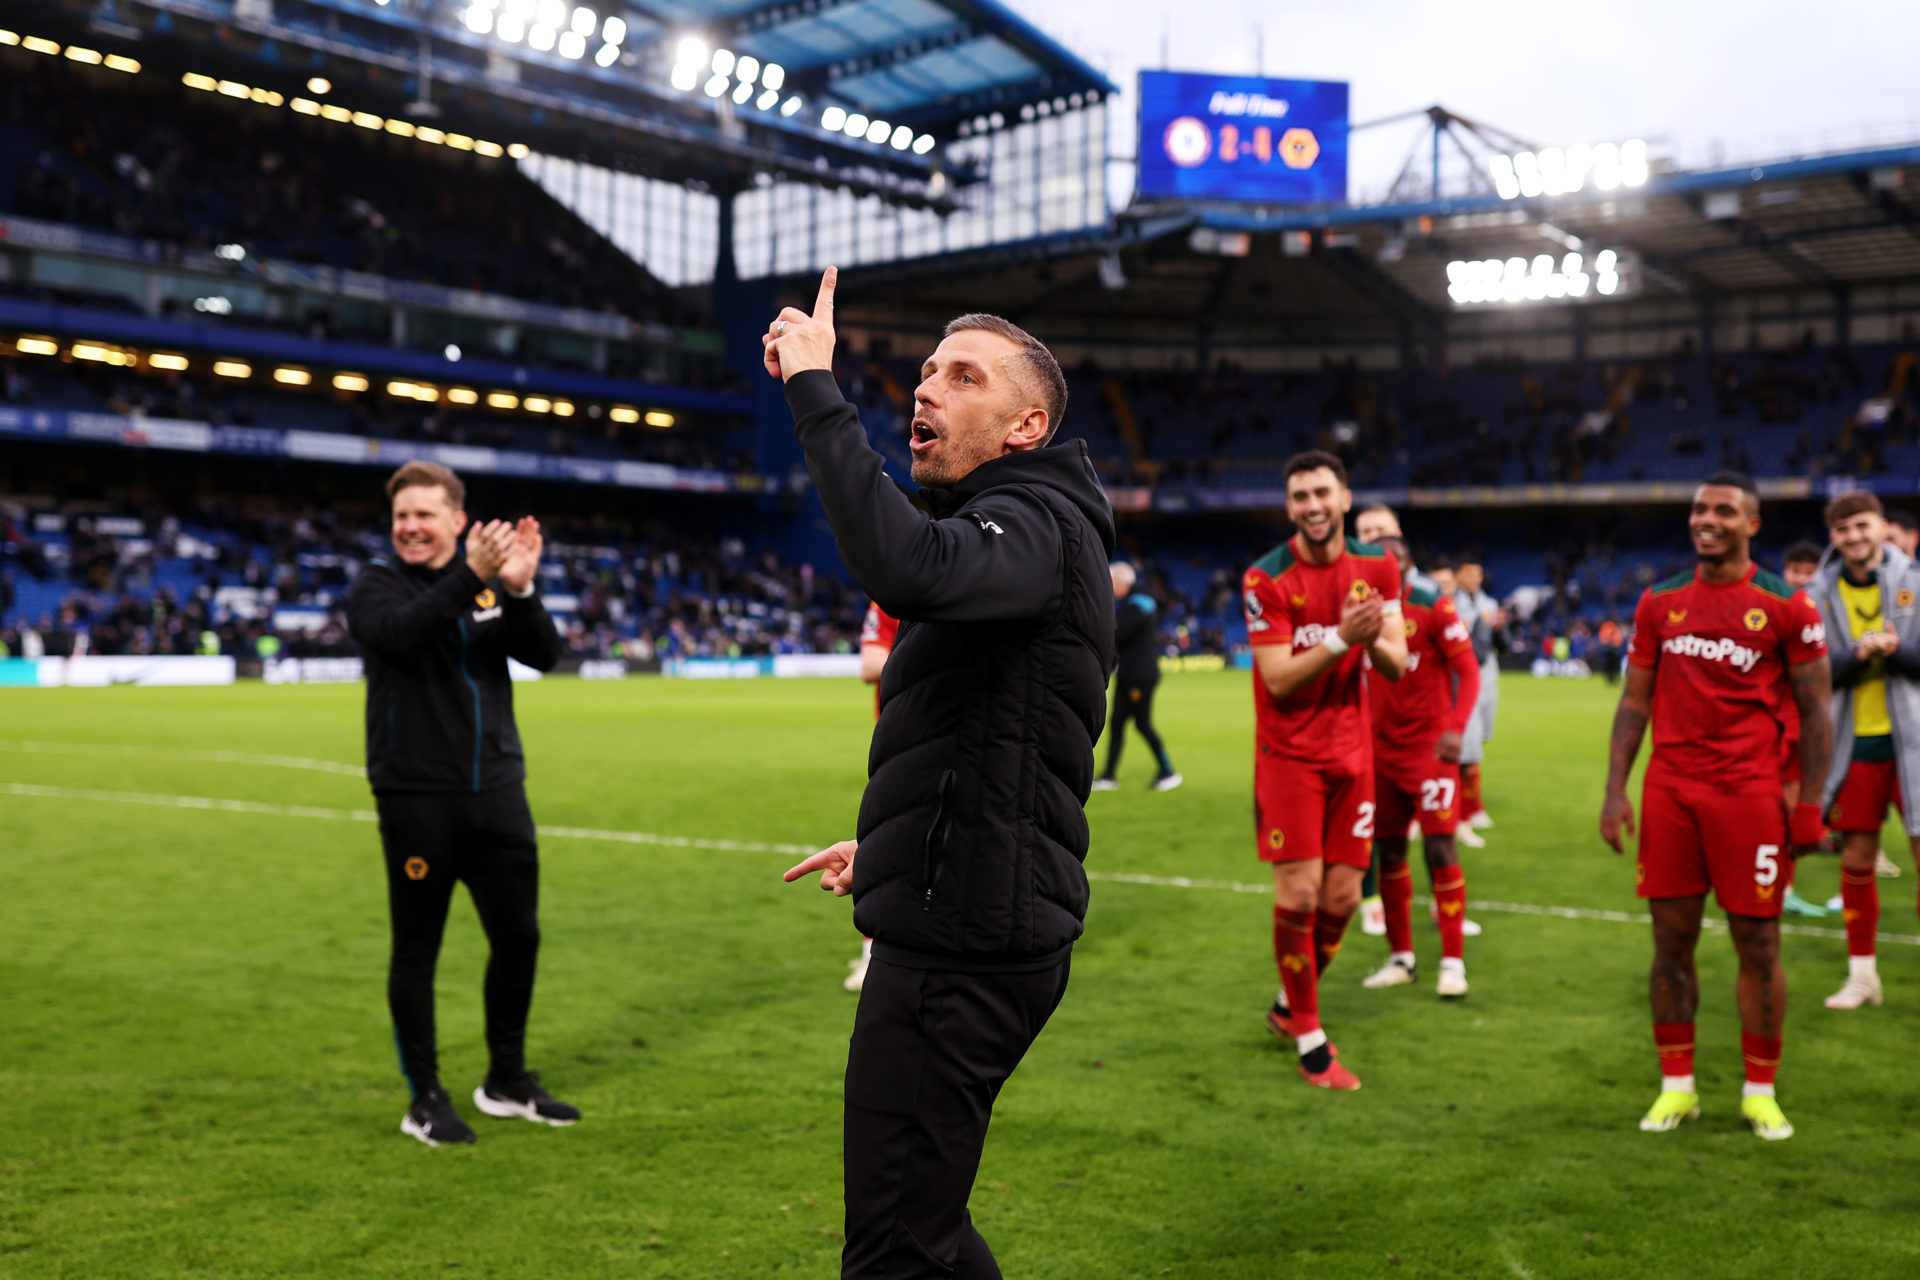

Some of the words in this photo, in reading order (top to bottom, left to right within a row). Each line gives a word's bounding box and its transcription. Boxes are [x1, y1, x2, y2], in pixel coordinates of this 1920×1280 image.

[1662, 633, 1762, 673] AstroPay
[1421, 777, 1455, 811] 27
[1352, 801, 1376, 838] 2
[1754, 844, 1779, 886] 5
